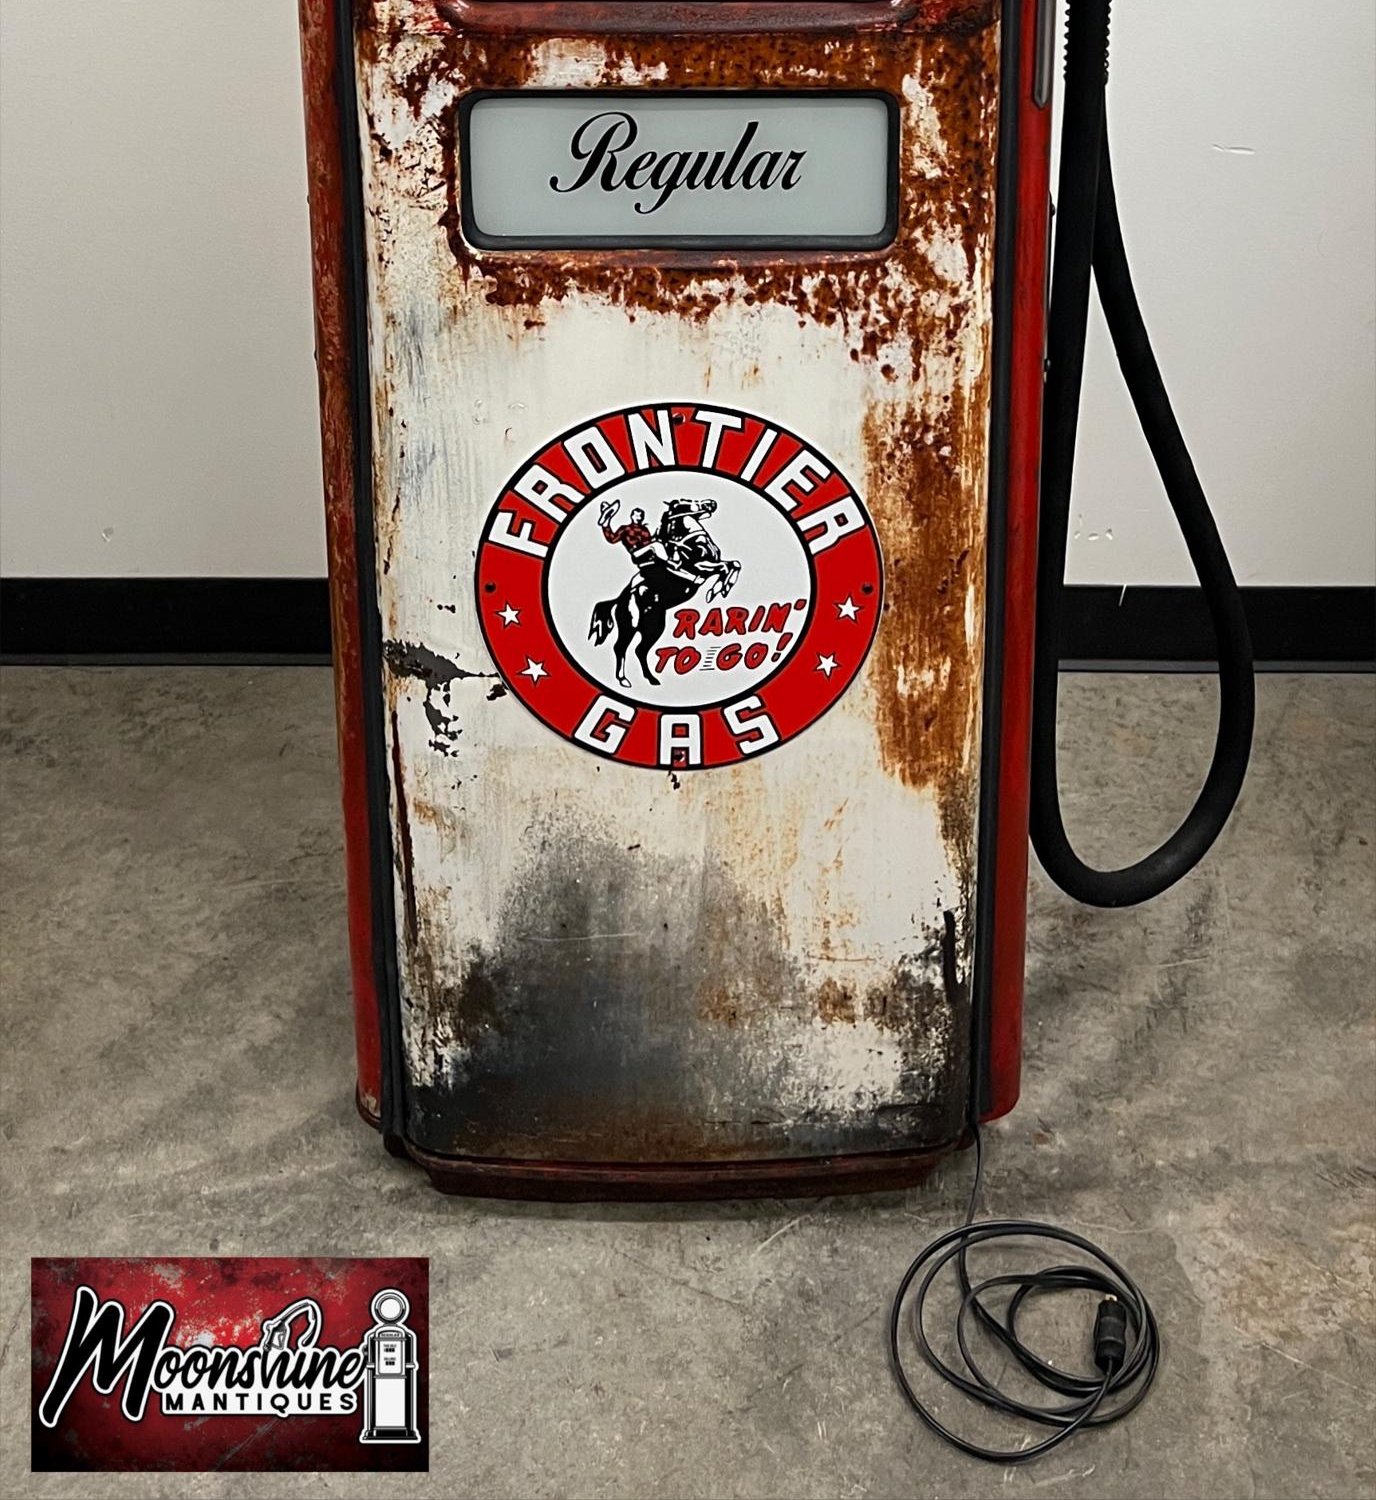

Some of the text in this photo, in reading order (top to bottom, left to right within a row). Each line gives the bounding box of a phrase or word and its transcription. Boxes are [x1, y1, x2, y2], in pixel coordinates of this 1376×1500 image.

[548, 111, 807, 214] Regular
[488, 409, 865, 558] FRONTIER
[655, 633, 793, 675] TO GO!
[673, 599, 807, 639] RARIN'
[574, 695, 780, 766] GAS
